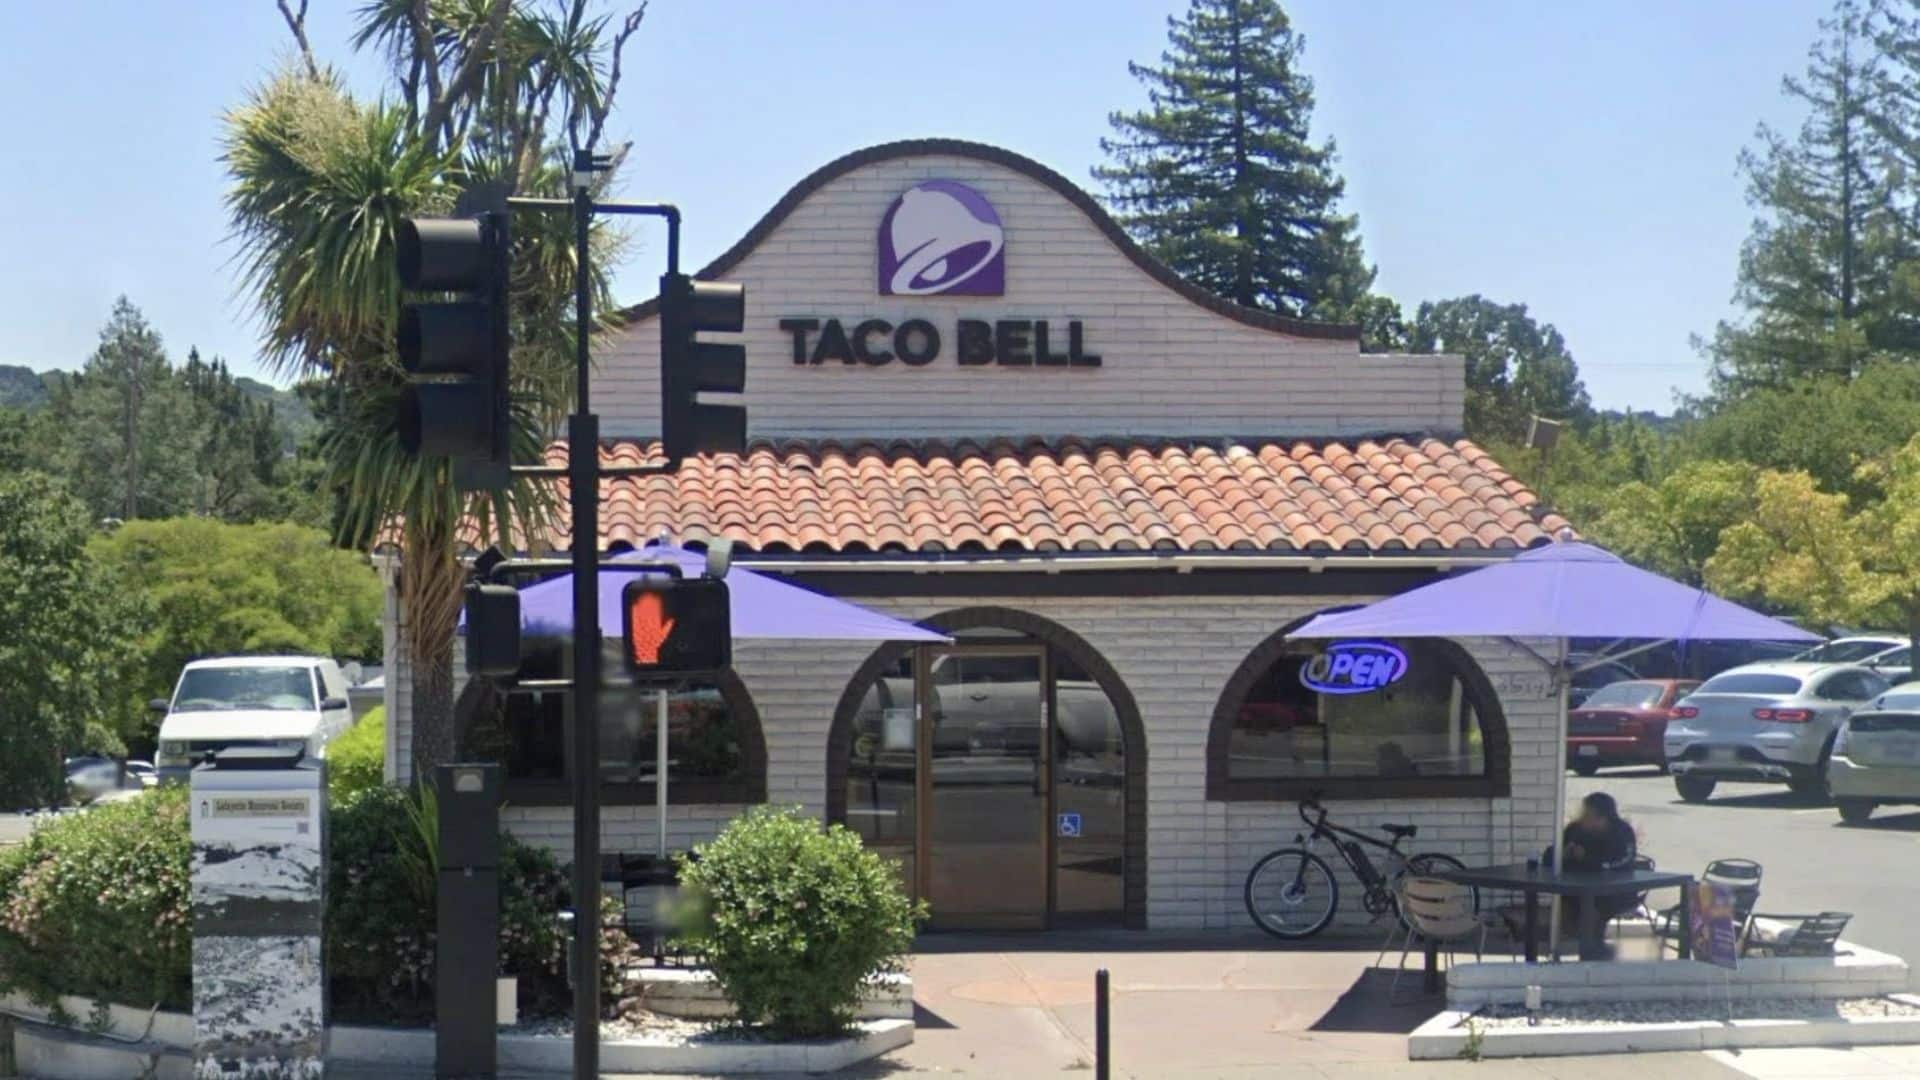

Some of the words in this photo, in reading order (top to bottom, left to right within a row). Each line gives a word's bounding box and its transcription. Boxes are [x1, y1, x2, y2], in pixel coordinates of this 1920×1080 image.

[779, 318, 941, 366] TACO
[957, 319, 1102, 367] BELL
[1306, 652, 1396, 686] OPEN
